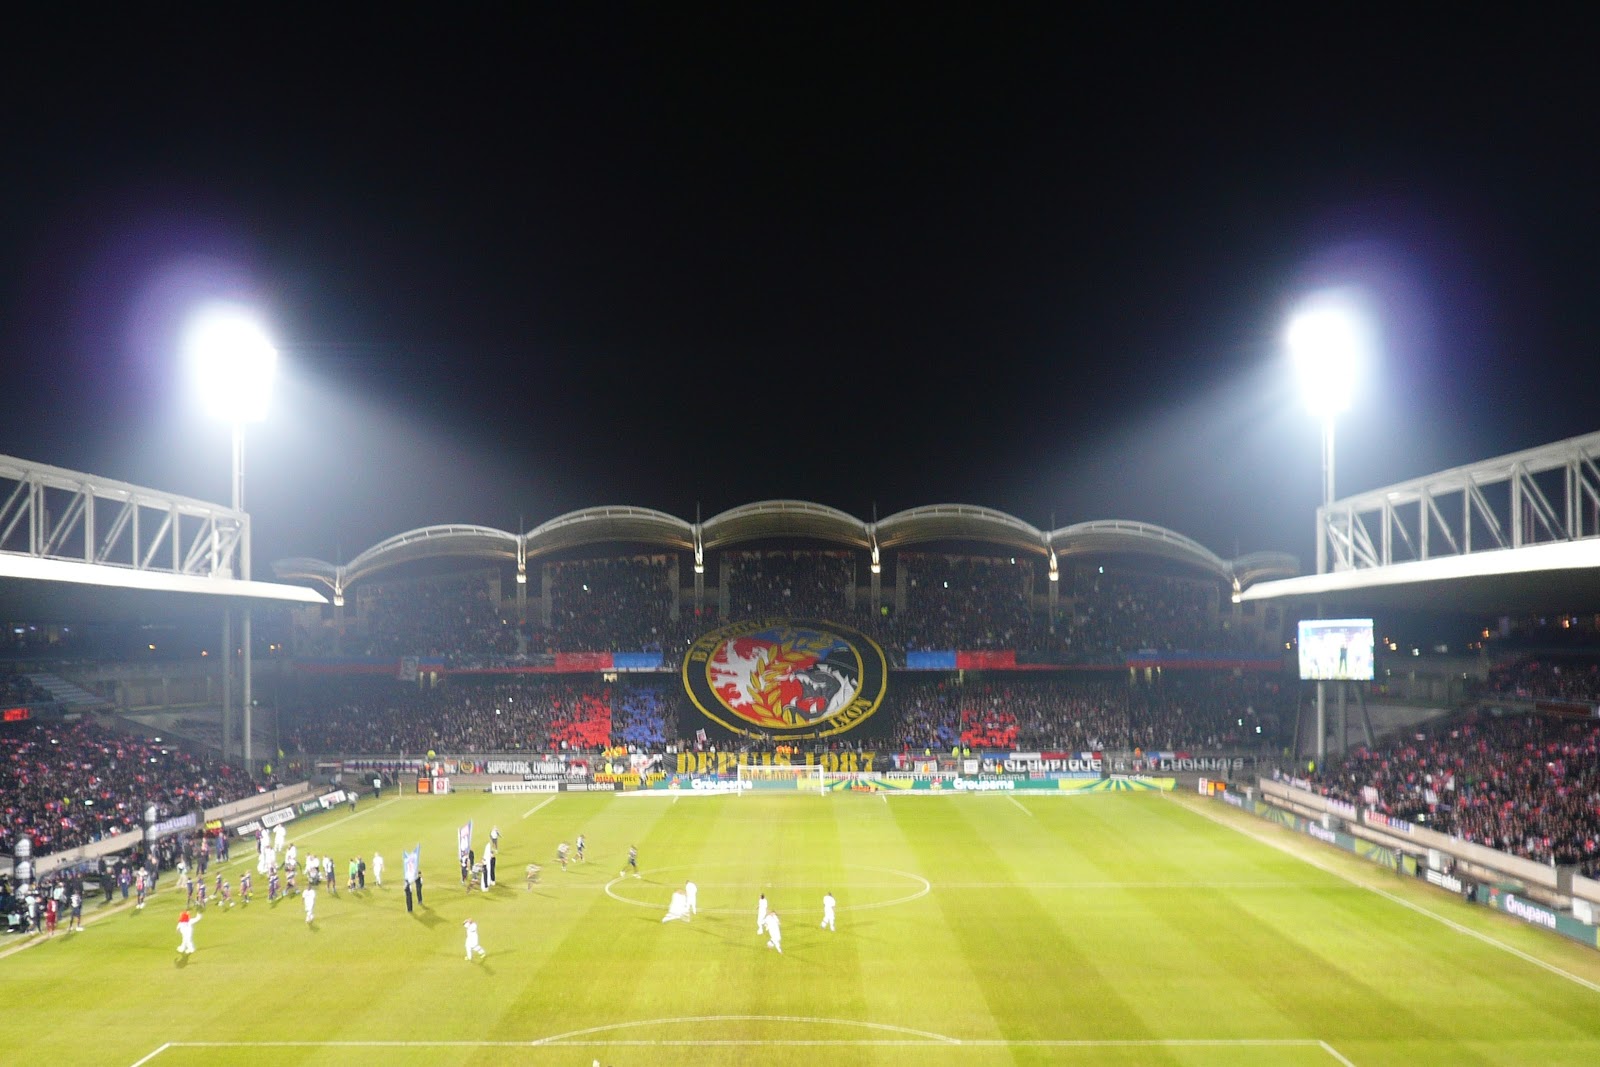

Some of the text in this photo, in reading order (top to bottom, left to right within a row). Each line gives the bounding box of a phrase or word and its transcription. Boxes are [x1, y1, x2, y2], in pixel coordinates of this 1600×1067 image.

[828, 697, 873, 729] LYON
[676, 752, 876, 775] DEPUIS 1987
[953, 778, 1015, 791] Groupama
[1506, 893, 1557, 928] Groupama
